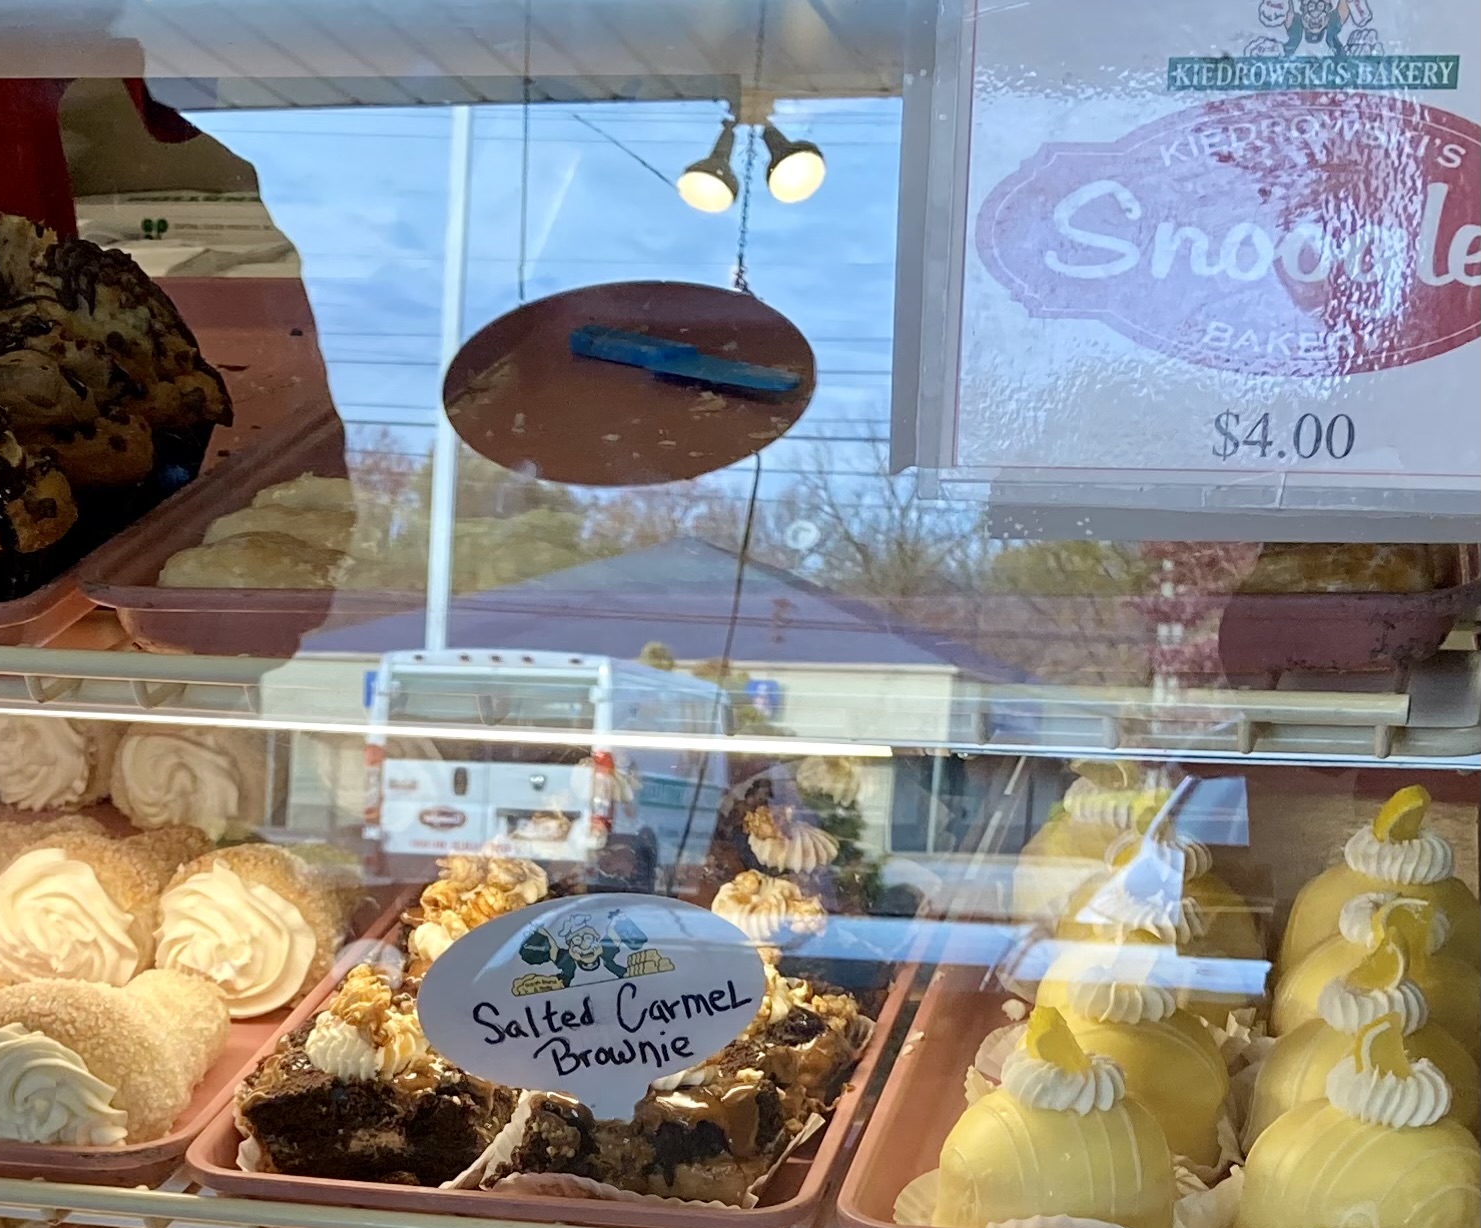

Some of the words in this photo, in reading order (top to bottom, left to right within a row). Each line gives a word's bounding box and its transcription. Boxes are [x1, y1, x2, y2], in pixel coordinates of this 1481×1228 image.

[1174, 61, 1351, 87] KIEDROWSKI'S
[1357, 60, 1454, 86] BAKERY
[1211, 409, 1357, 461] $4.00
[472, 993, 596, 1046] Salted
[532, 1031, 696, 1077] Brownie
